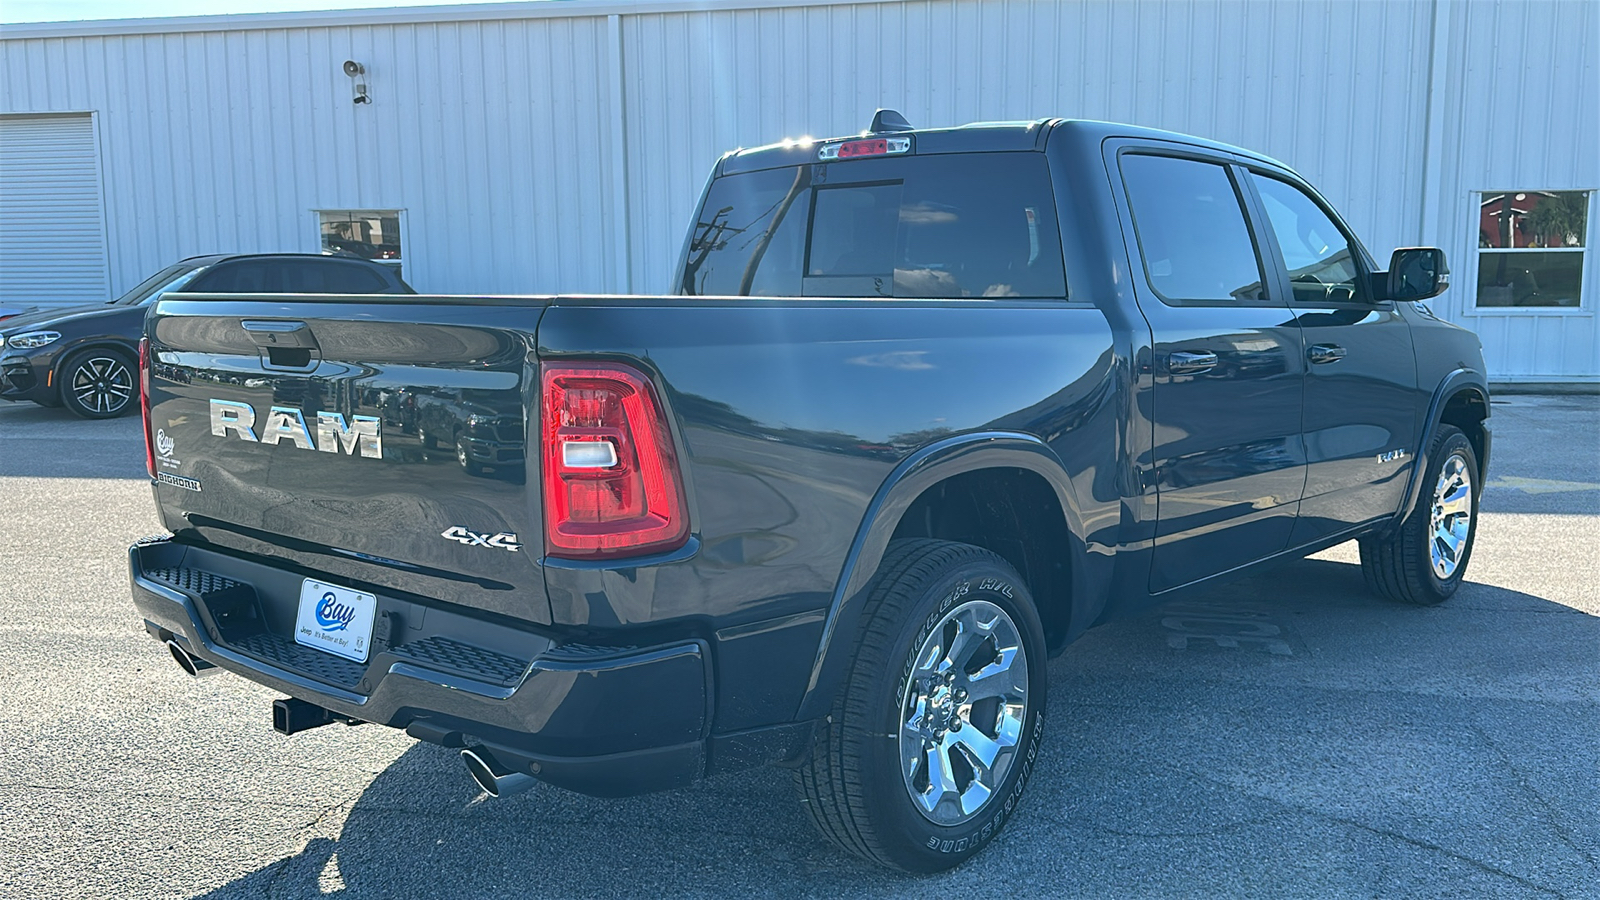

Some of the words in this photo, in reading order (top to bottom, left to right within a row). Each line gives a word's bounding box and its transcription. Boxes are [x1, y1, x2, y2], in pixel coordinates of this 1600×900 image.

[209, 398, 383, 460] RAM
[317, 592, 356, 631] Bay
[926, 711, 1044, 853] BRIDGESTONE
